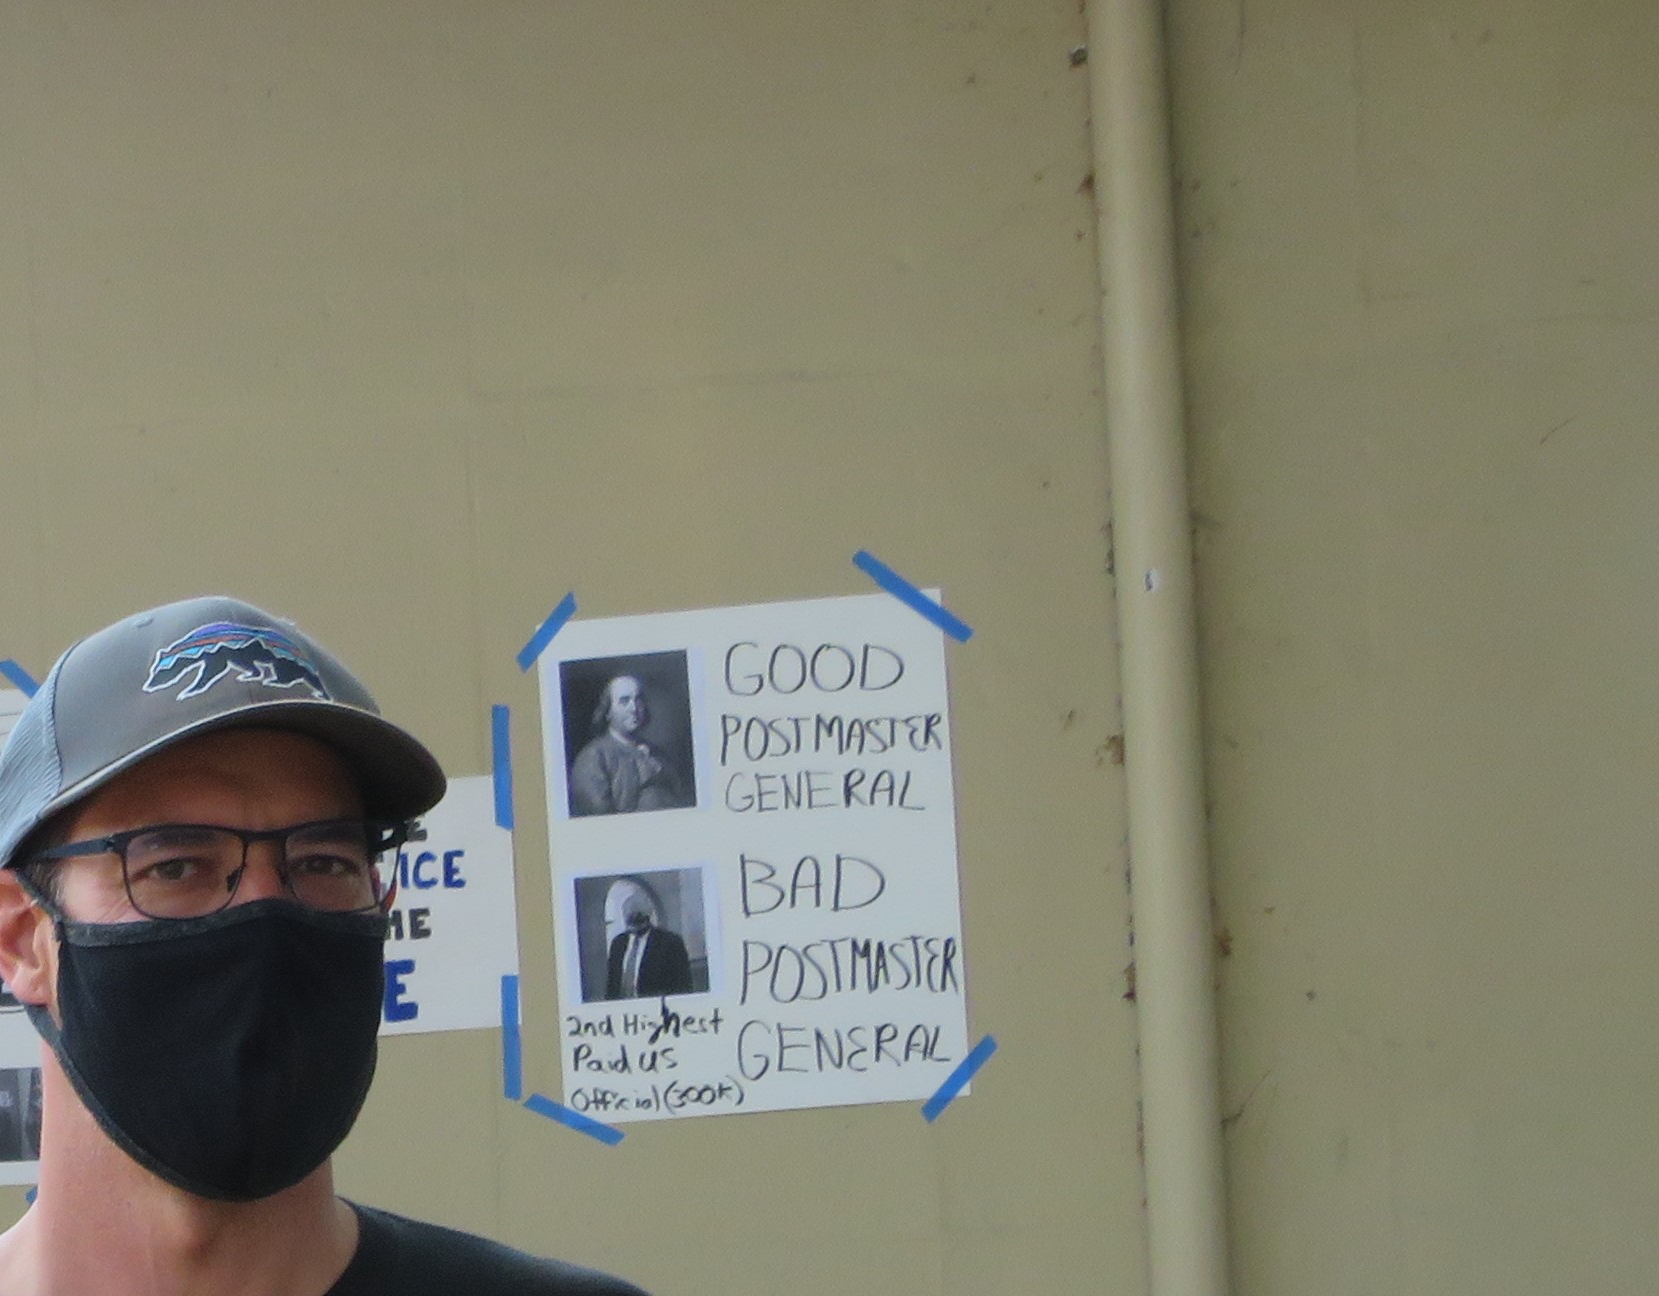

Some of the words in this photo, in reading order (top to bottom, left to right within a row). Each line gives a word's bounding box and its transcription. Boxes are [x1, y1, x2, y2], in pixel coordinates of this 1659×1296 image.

[724, 640, 905, 697] GOOD
[720, 712, 943, 767] POSTMASTER
[724, 768, 926, 813] GENERAL
[739, 853, 887, 919] BAD
[739, 934, 959, 1006] POSTMASTER
[566, 1013, 615, 1038] 2nd
[622, 995, 724, 1046] Highest
[572, 1042, 632, 1074] Paid
[737, 1019, 952, 1082] GENERAL
